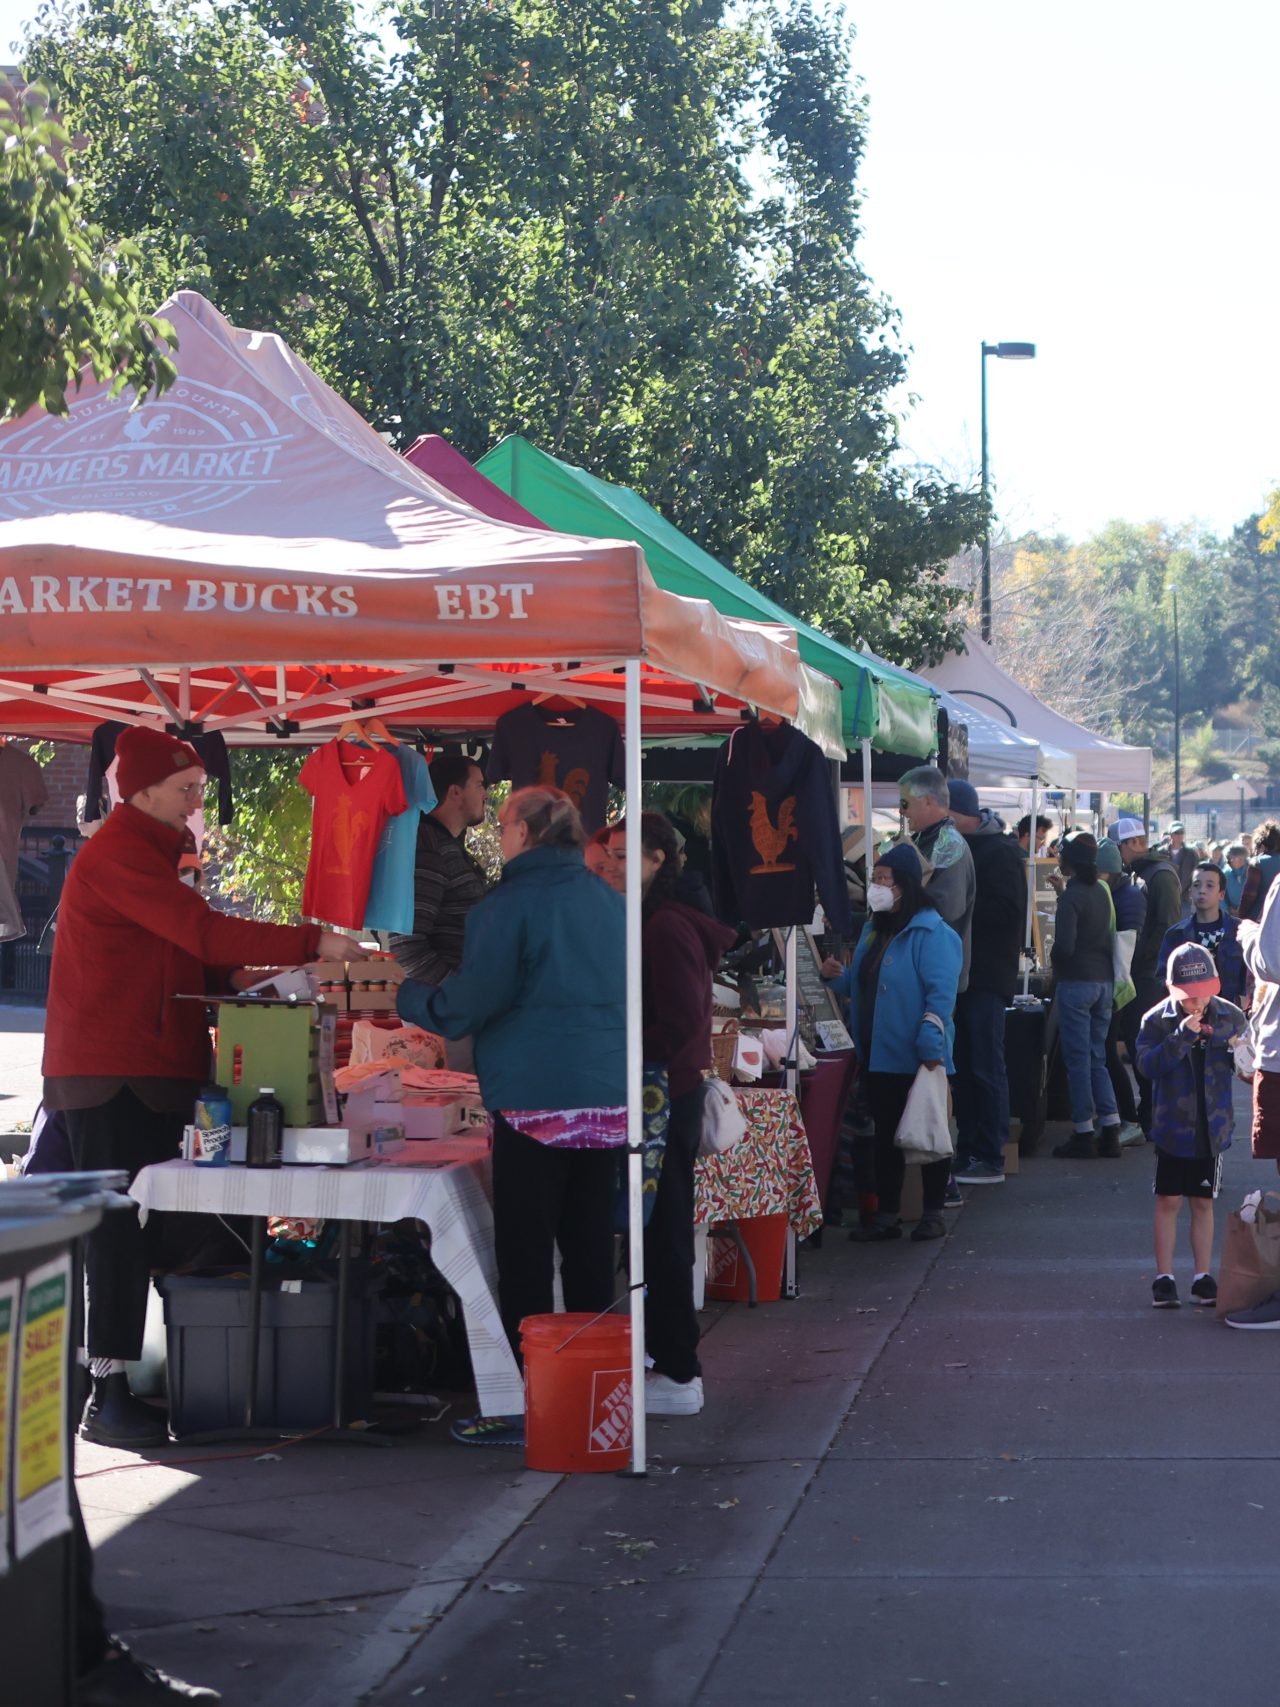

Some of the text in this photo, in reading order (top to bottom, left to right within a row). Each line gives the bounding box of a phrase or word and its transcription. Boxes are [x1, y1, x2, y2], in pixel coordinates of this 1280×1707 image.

[138, 444, 282, 477] MARKET
[184, 579, 359, 618] BUCKS
[433, 583, 534, 620] EBT
